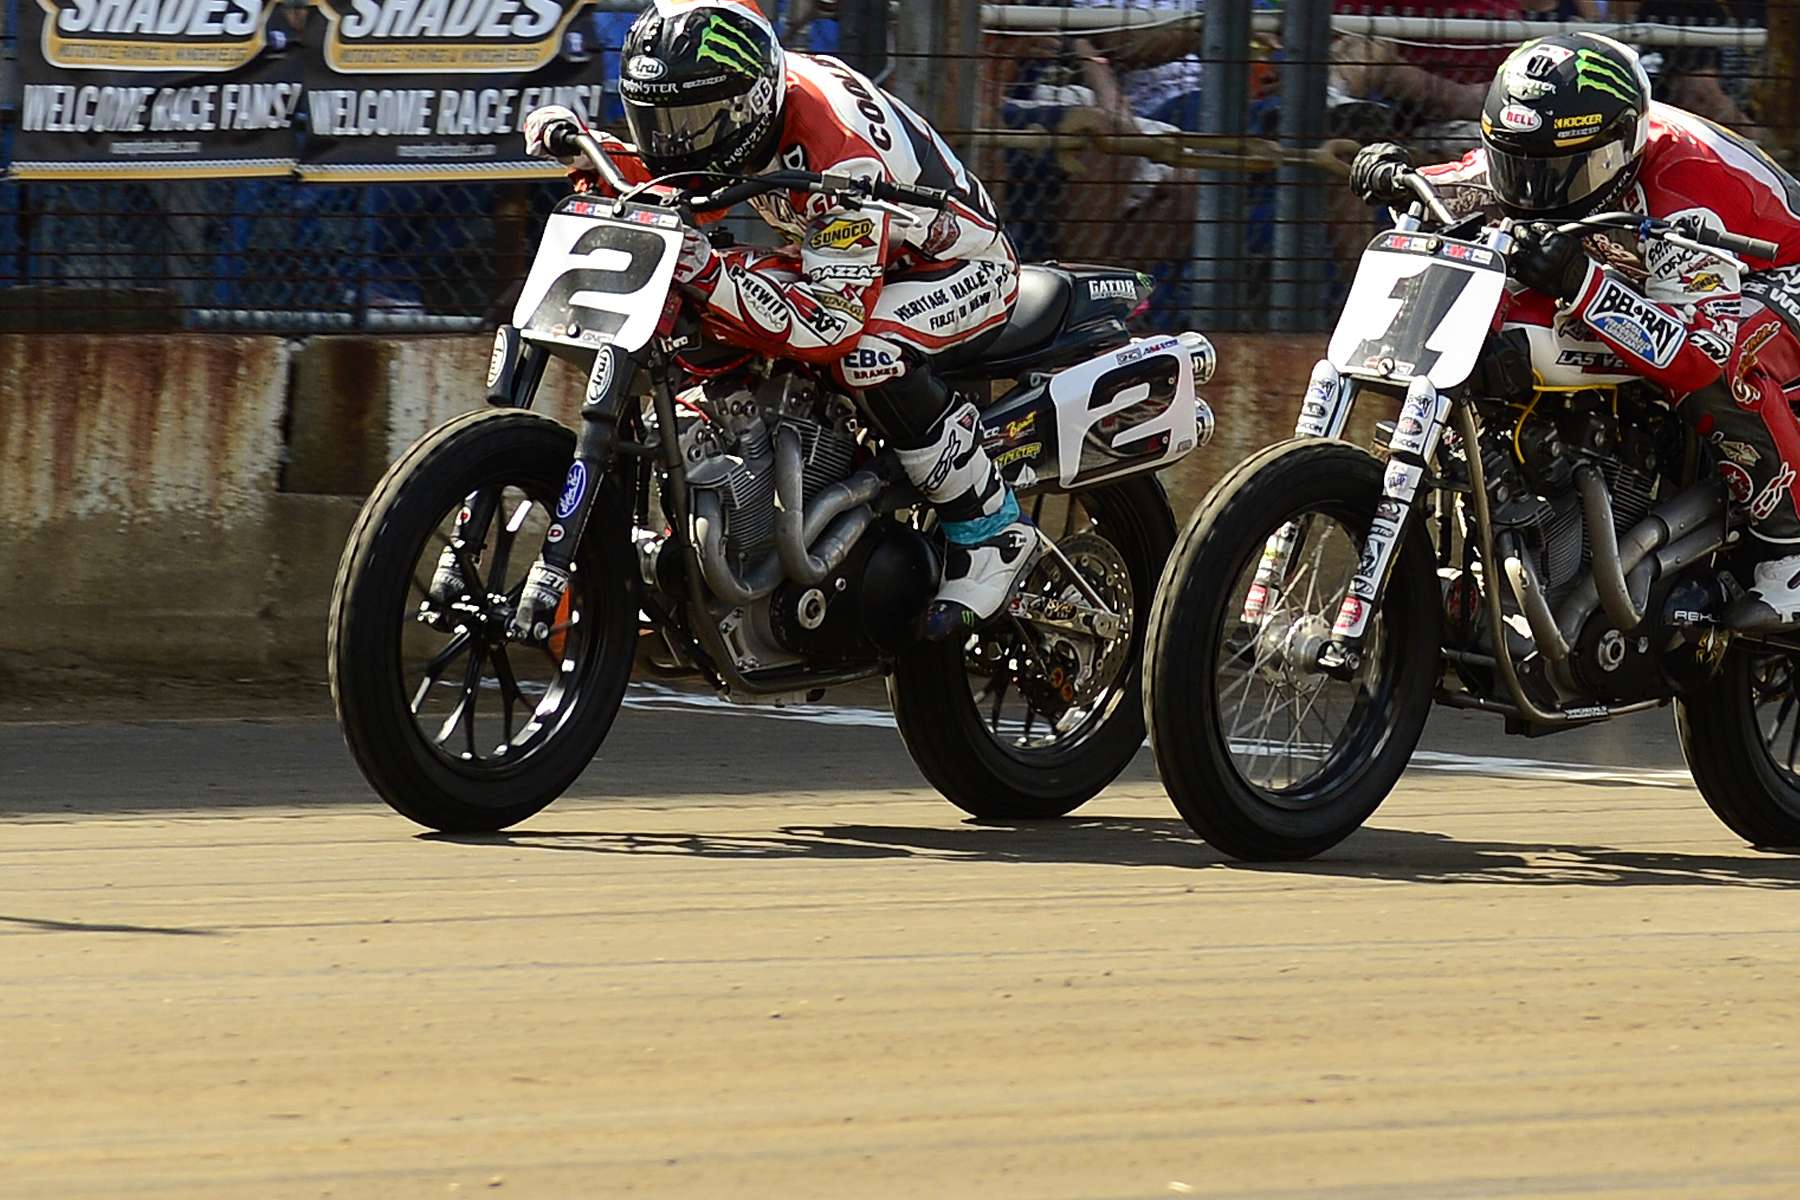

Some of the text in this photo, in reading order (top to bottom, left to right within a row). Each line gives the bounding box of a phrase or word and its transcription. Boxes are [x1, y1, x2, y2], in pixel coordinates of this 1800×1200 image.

[22, 85, 155, 132] WELCOME
[308, 90, 435, 136] WELCOME
[436, 89, 518, 135] RACE
[1505, 110, 1535, 127] BELL
[811, 222, 872, 246] SUNOCO
[525, 224, 667, 338] 2
[1088, 279, 1137, 294] GATOR
[1345, 262, 1477, 378] 1
